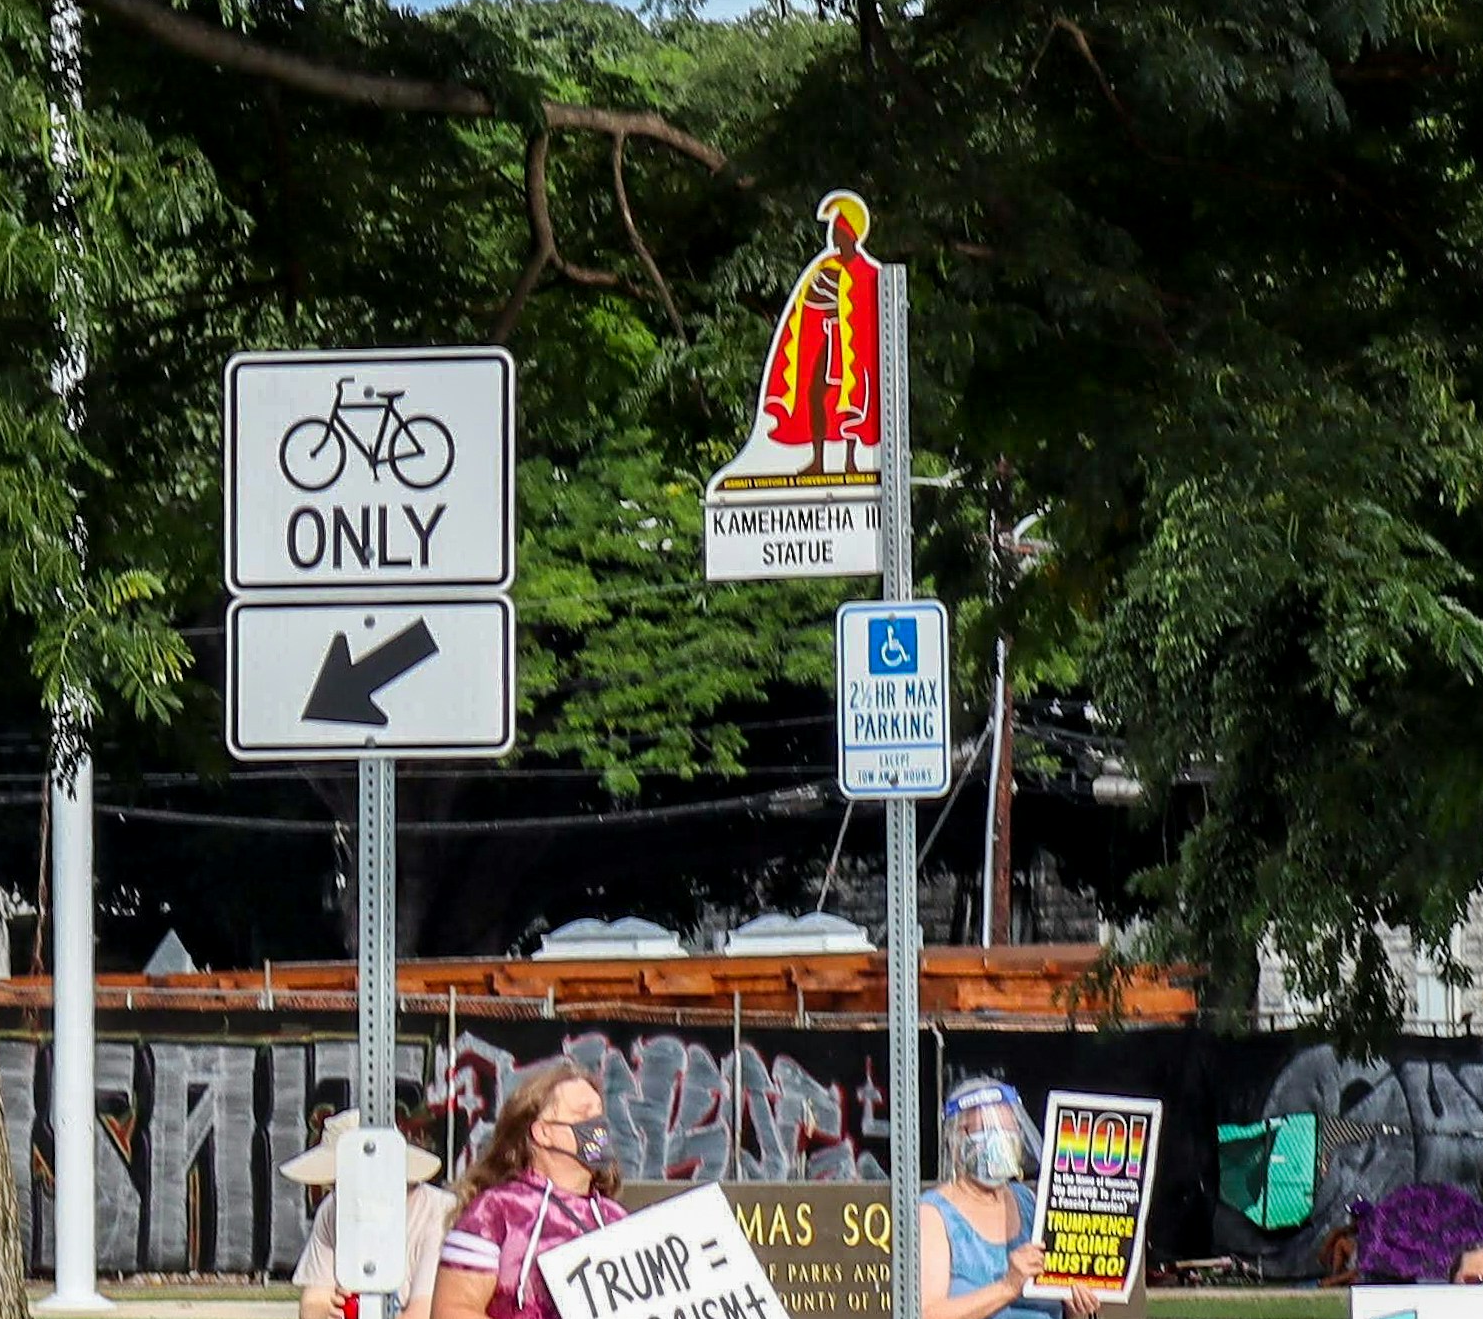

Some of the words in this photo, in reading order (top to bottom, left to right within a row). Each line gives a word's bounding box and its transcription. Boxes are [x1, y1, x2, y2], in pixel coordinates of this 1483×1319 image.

[713, 505, 855, 537] KAMEHAMEHA
[286, 504, 447, 570] ONLY
[763, 540, 833, 566] STATUE
[905, 679, 938, 708] MAX
[854, 711, 935, 740] PARKING
[879, 753, 910, 767] EXCEPT
[904, 769, 933, 782] HOURS
[1054, 1109, 1148, 1179] NO!
[843, 1202, 891, 1254] SQ
[1054, 1232, 1120, 1255] REGIME
[567, 1234, 690, 1319] TRUMP
[701, 1238, 728, 1270] =
[788, 1262, 842, 1283] PARKS
[854, 1263, 891, 1283] AND
[1044, 1251, 1091, 1274] MUST
[1093, 1255, 1126, 1277] GO!
[848, 1291, 869, 1311] OF
